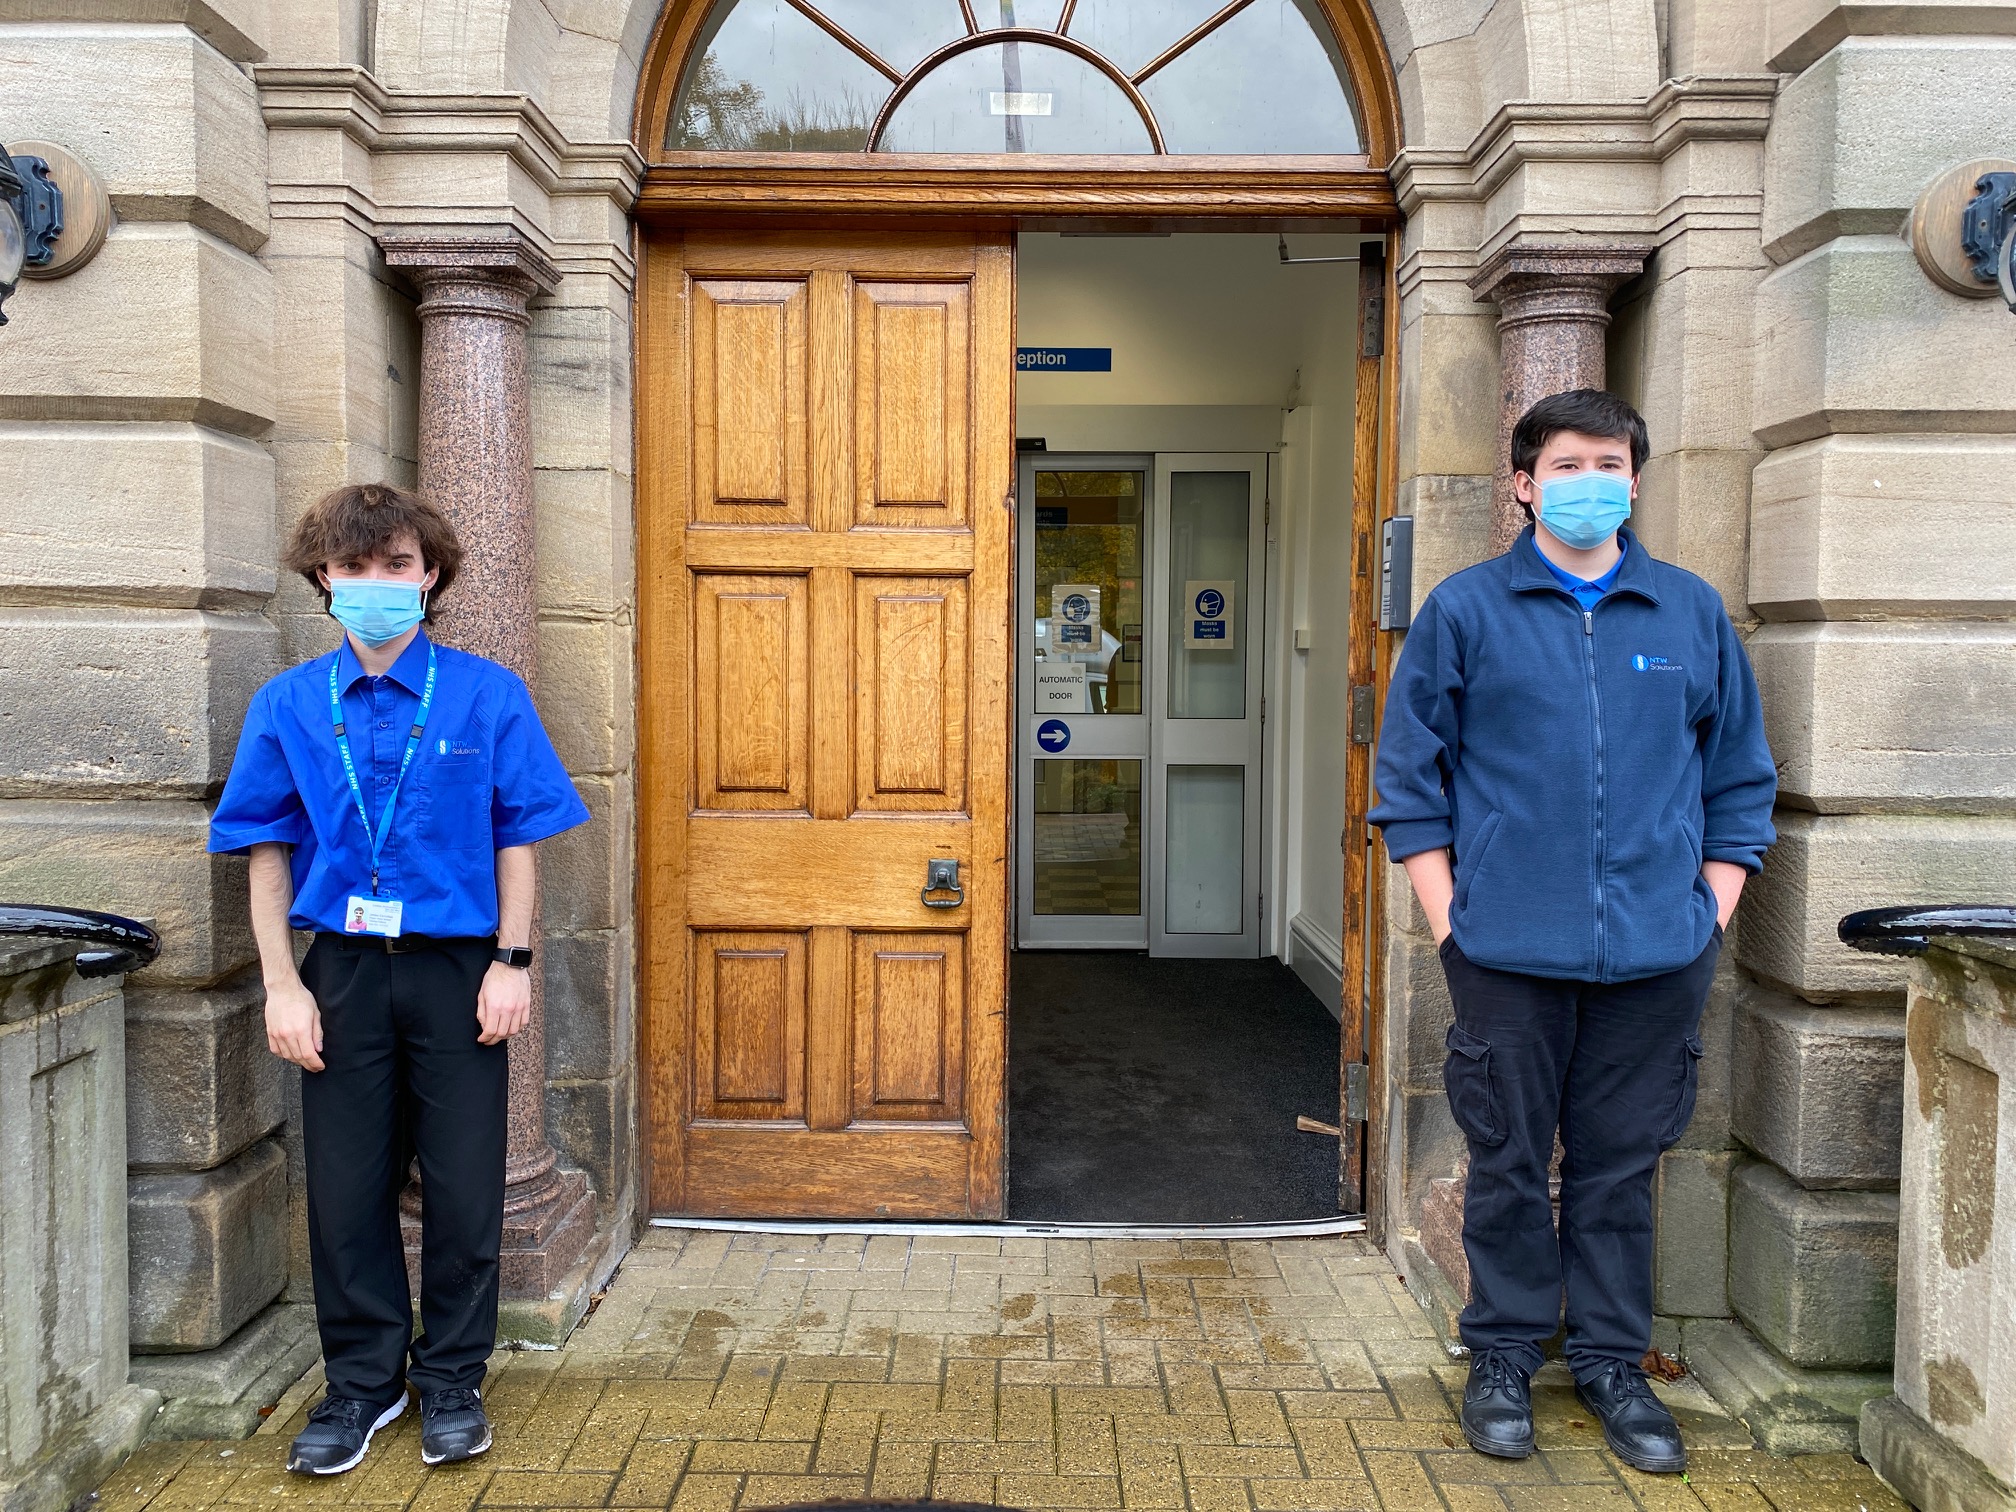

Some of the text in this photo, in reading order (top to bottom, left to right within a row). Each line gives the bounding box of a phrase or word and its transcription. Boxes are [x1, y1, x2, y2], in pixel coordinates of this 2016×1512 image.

[1017, 351, 1067, 368] eption
[1650, 663, 1683, 671] Solutions
[427, 666, 435, 682] NHS
[1039, 676, 1083, 684] AUTOMATIC
[422, 683, 433, 709] STAFF
[1049, 692, 1073, 700] DOOR
[452, 740, 468, 748] NTW
[403, 747, 414, 766] NHS
[452, 747, 480, 755] Solutions
[341, 744, 359, 790] NHS STAFF
